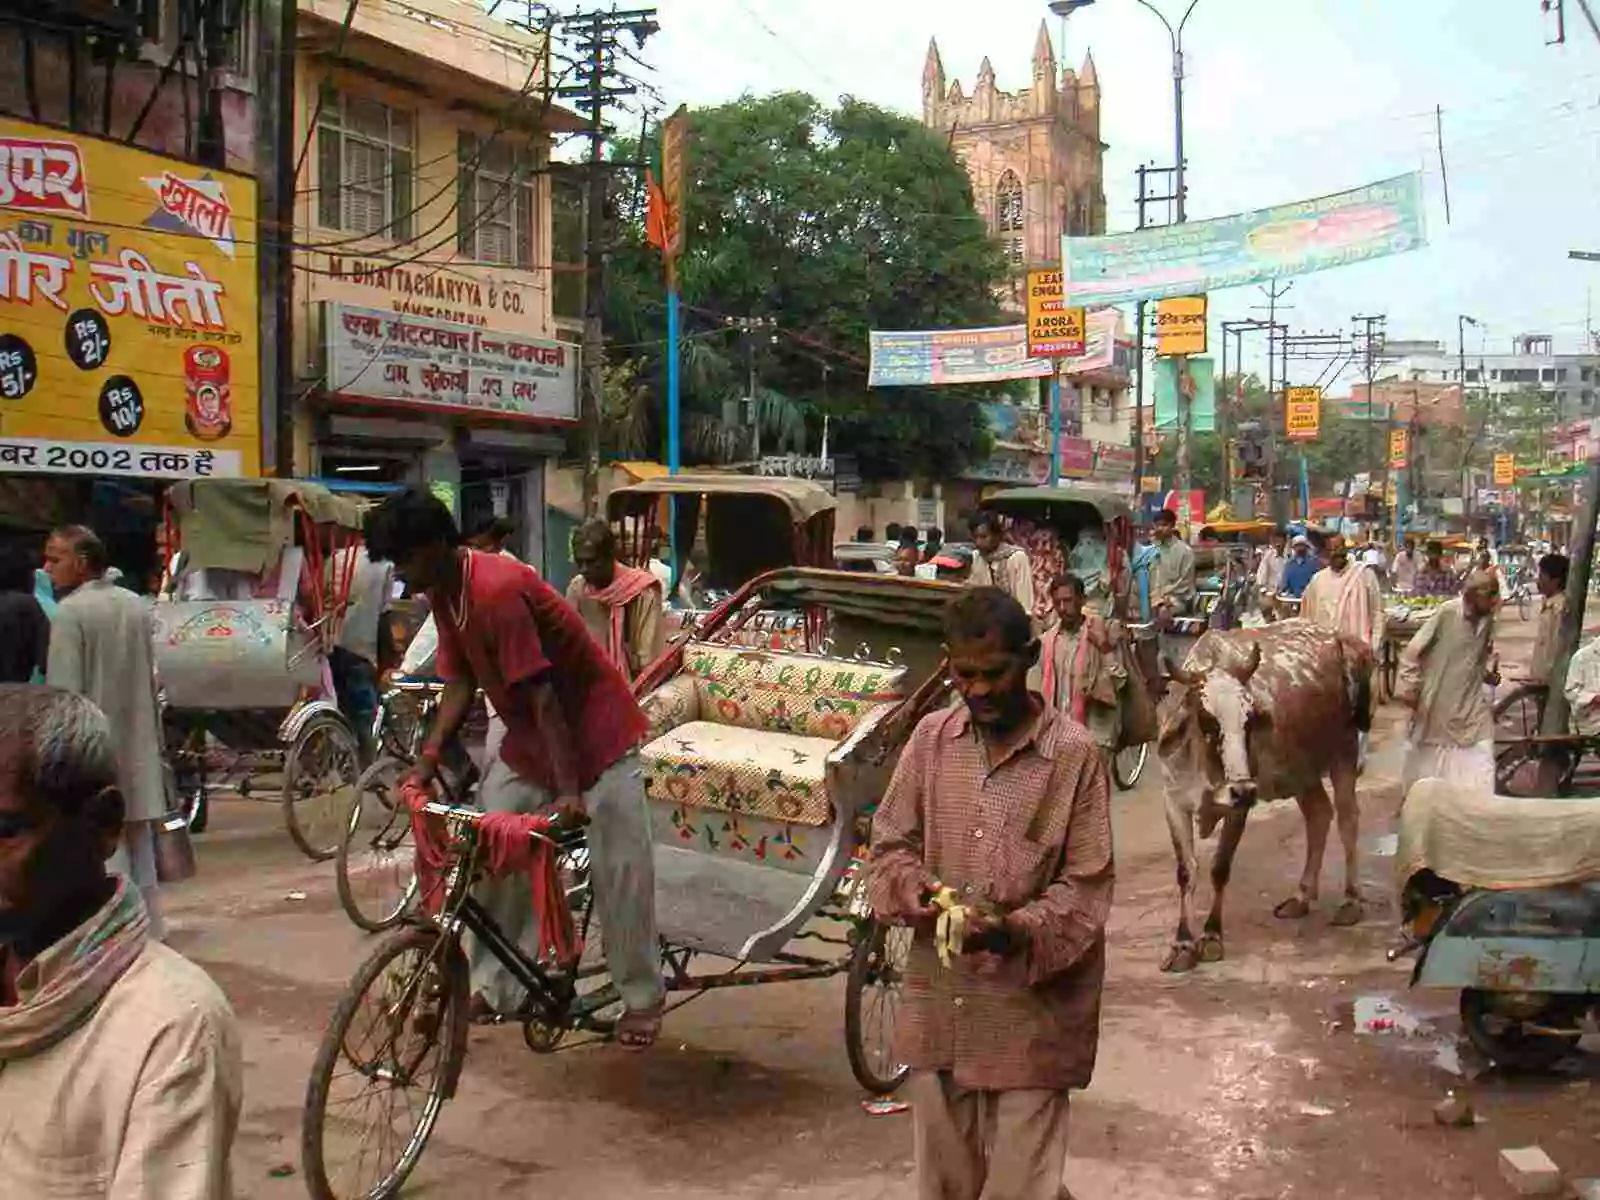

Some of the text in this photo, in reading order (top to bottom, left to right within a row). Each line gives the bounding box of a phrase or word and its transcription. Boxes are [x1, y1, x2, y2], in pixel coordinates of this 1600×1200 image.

[89, 247, 226, 329] जीतो
[328, 253, 348, 281] M.
[502, 290, 525, 315] CO.
[74, 320, 97, 340] Rs
[81, 332, 108, 363] 2/-
[2, 366, 32, 397] 5/-
[107, 387, 132, 407] Rs
[111, 399, 142, 431] 10/-
[47, 446, 132, 470] 2002
[140, 451, 189, 472] तक
[194, 449, 214, 477] है
